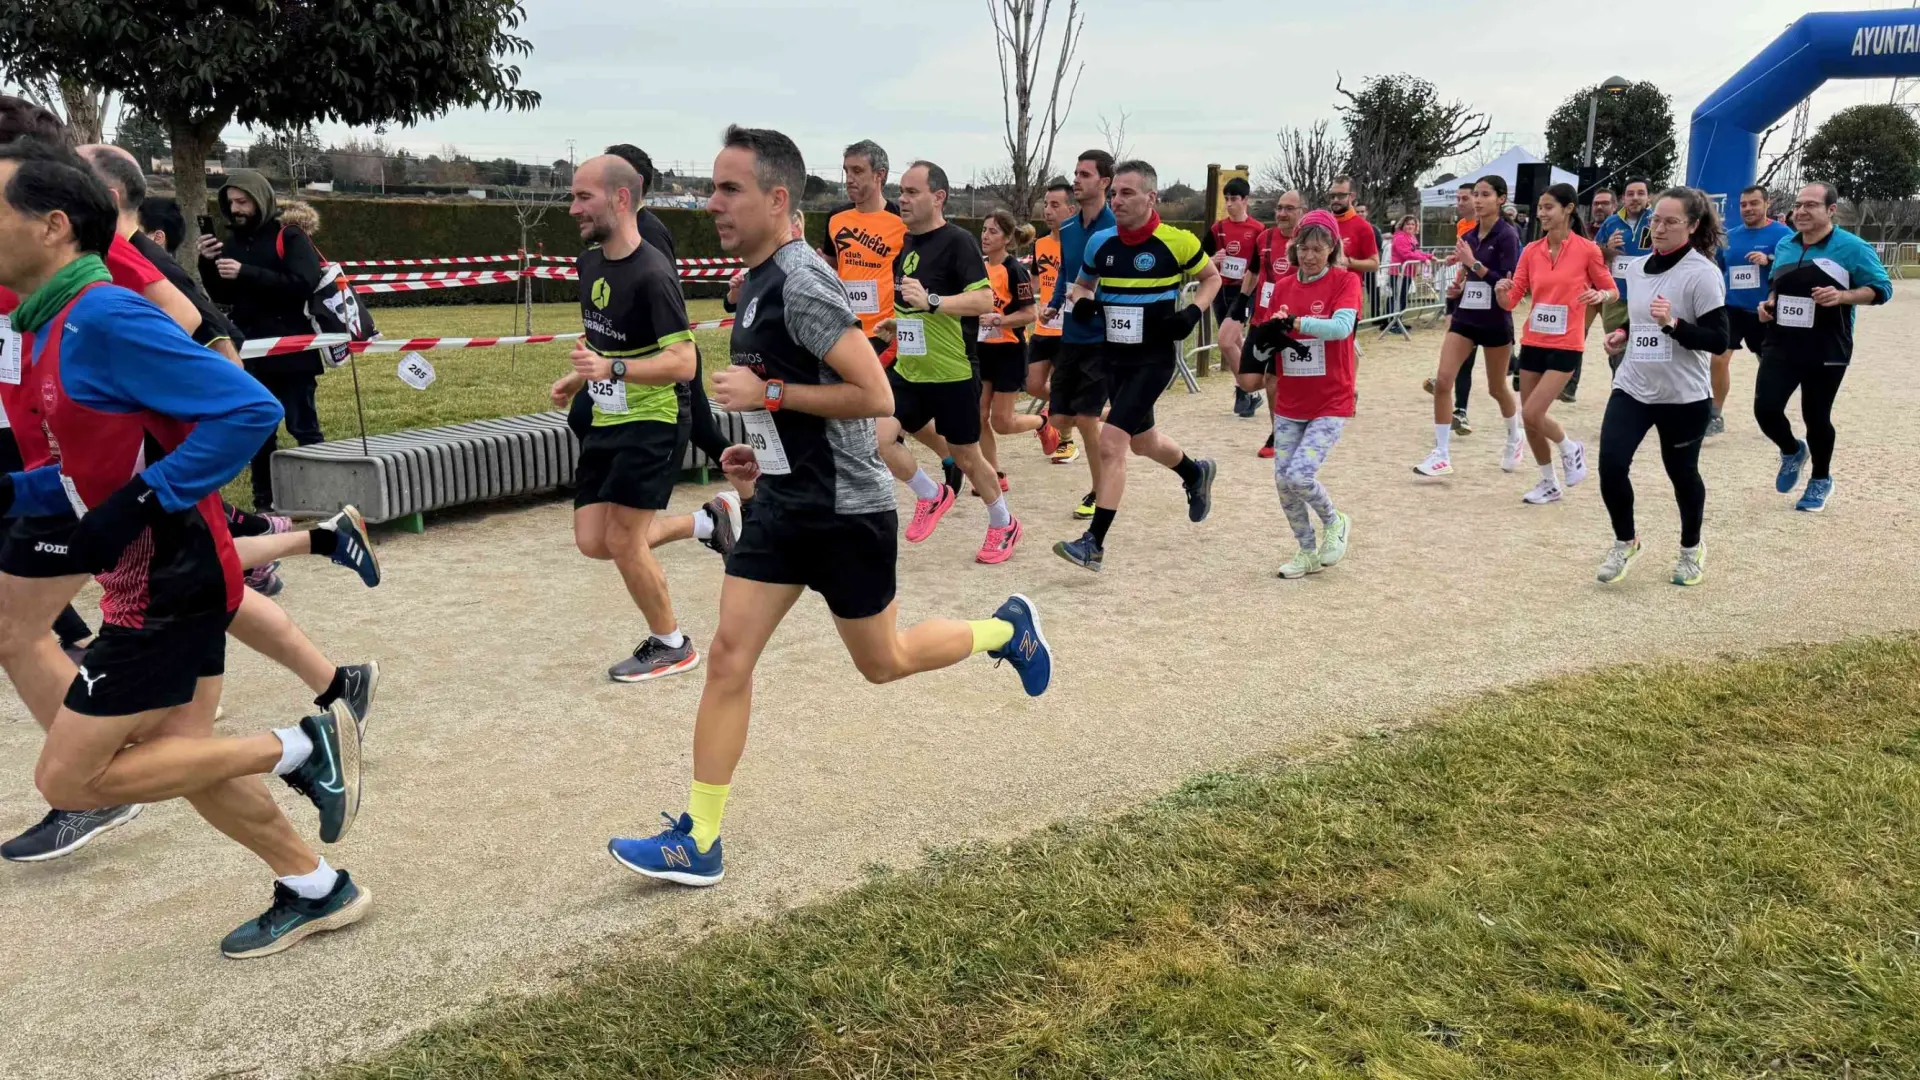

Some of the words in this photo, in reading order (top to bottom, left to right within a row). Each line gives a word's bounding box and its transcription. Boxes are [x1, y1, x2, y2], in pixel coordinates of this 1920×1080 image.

[844, 251, 862, 259] club
[844, 258, 882, 269] atletismo
[1224, 262, 1239, 272] 310
[1734, 272, 1752, 281] 480
[849, 291, 868, 301] 409
[1782, 305, 1804, 316] 550
[1537, 313, 1557, 324] 580
[1110, 319, 1131, 330] 354
[1636, 336, 1659, 348] 508
[408, 363, 428, 380] 285
[592, 381, 614, 397] 525
